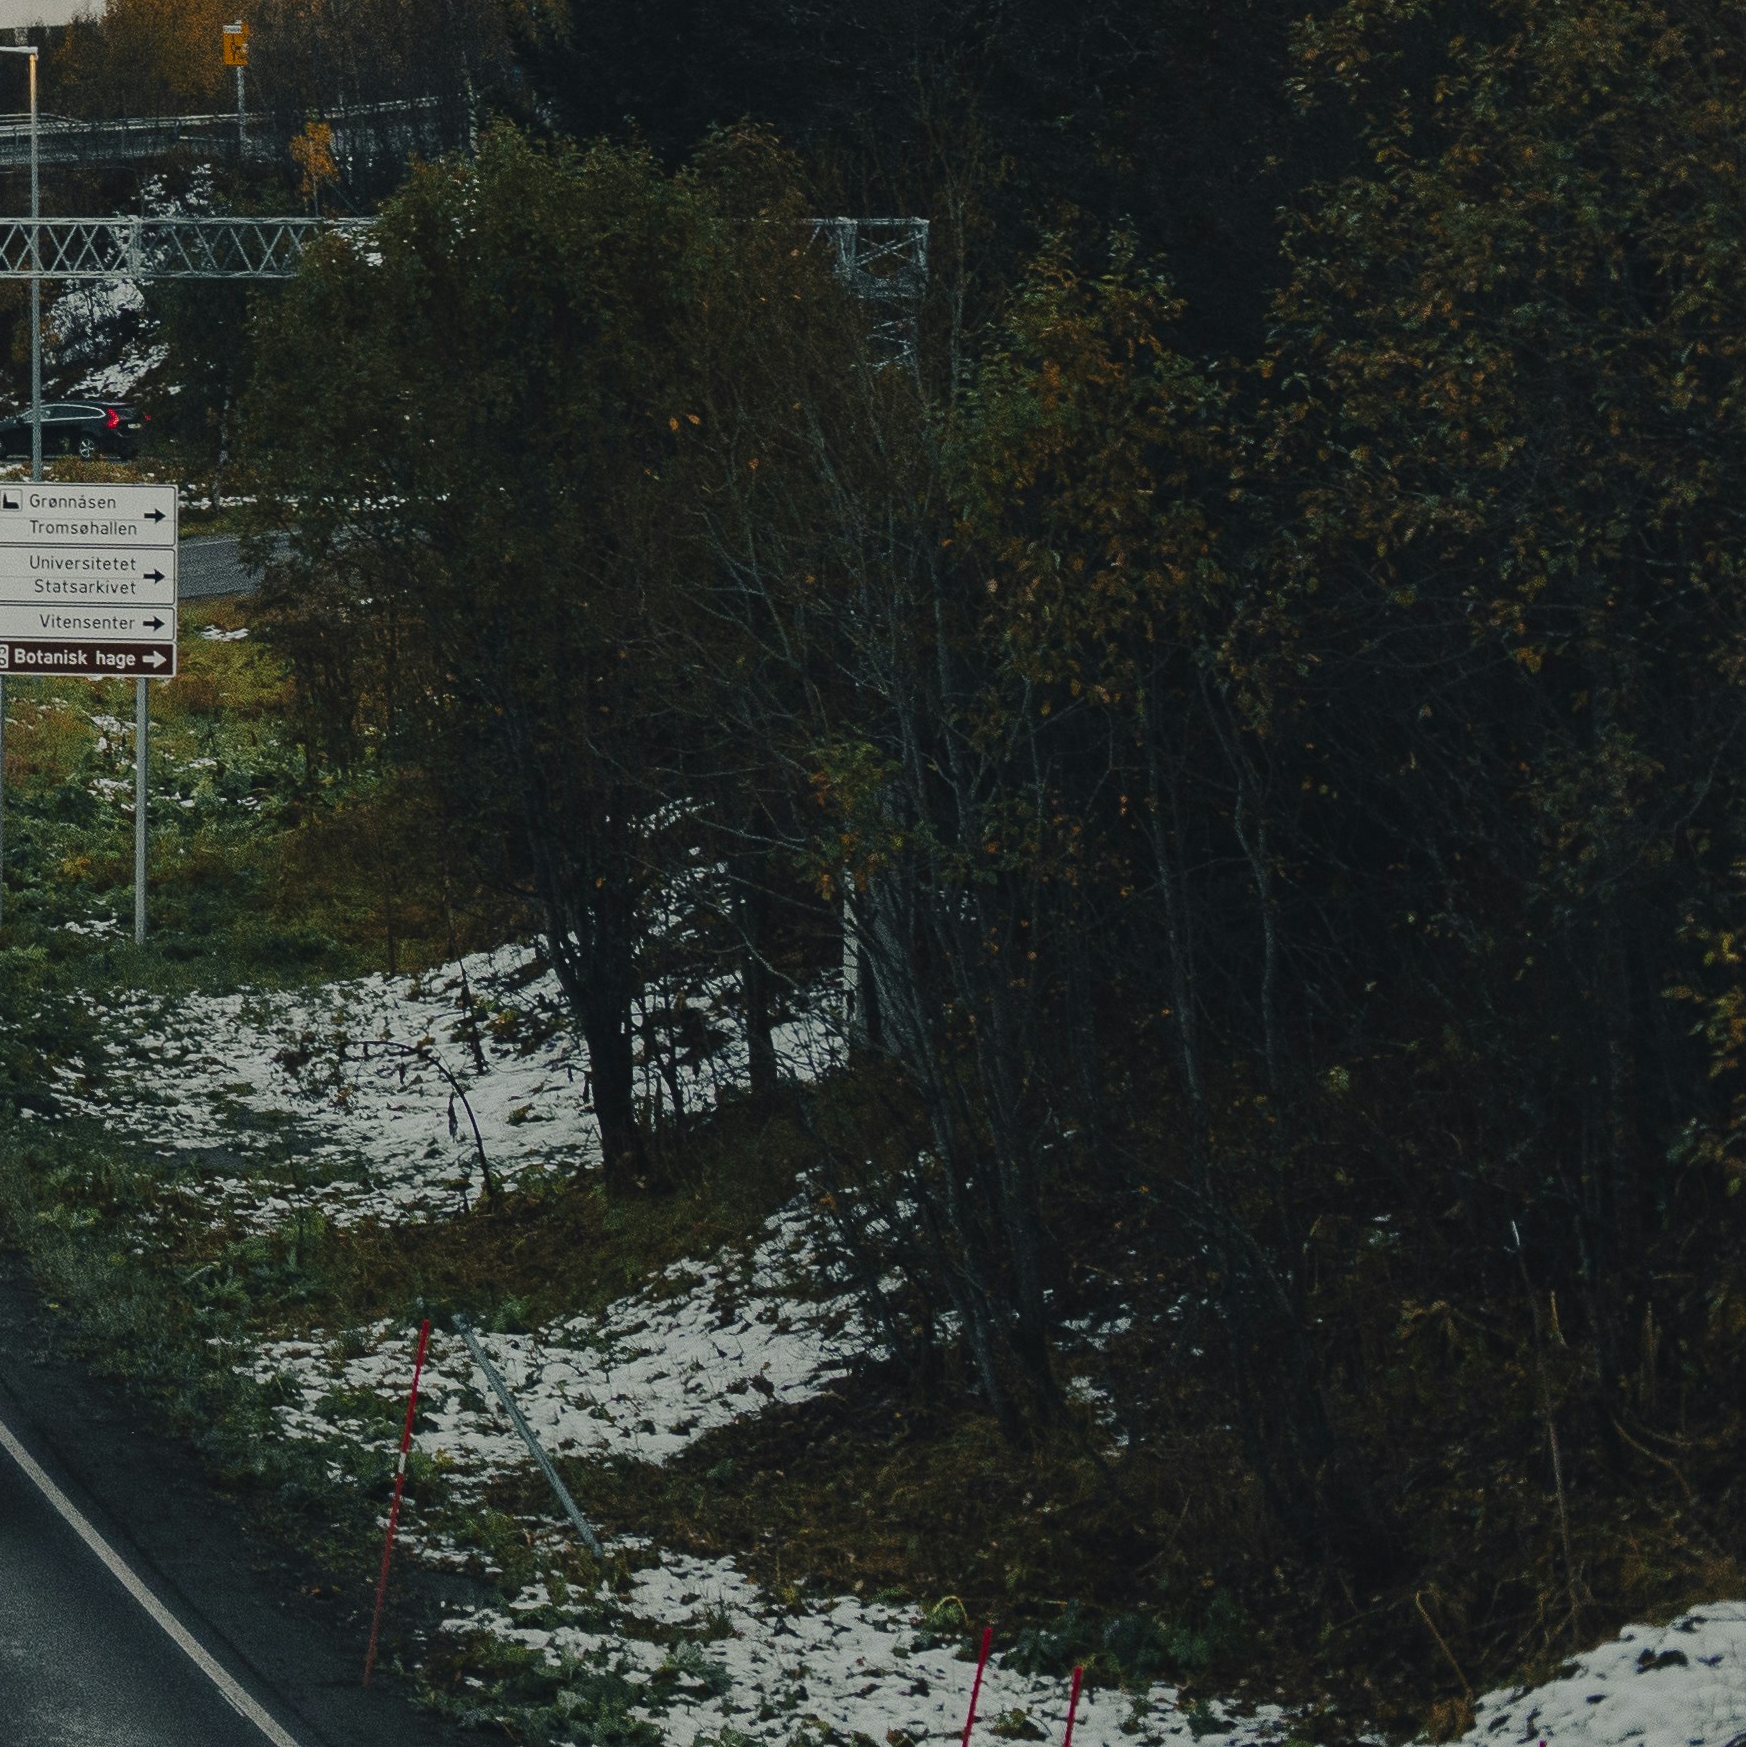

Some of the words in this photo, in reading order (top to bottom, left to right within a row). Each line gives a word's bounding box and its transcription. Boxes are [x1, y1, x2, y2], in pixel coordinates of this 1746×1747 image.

[29, 493, 117, 509] Grønnåsen
[30, 520, 137, 535] Tromsøhallen
[29, 555, 136, 571] Universitetet
[34, 579, 136, 595] Statsarkivet
[39, 614, 135, 630] Vitensenter
[14, 648, 87, 665] Botanisk
[95, 650, 136, 669] hage
